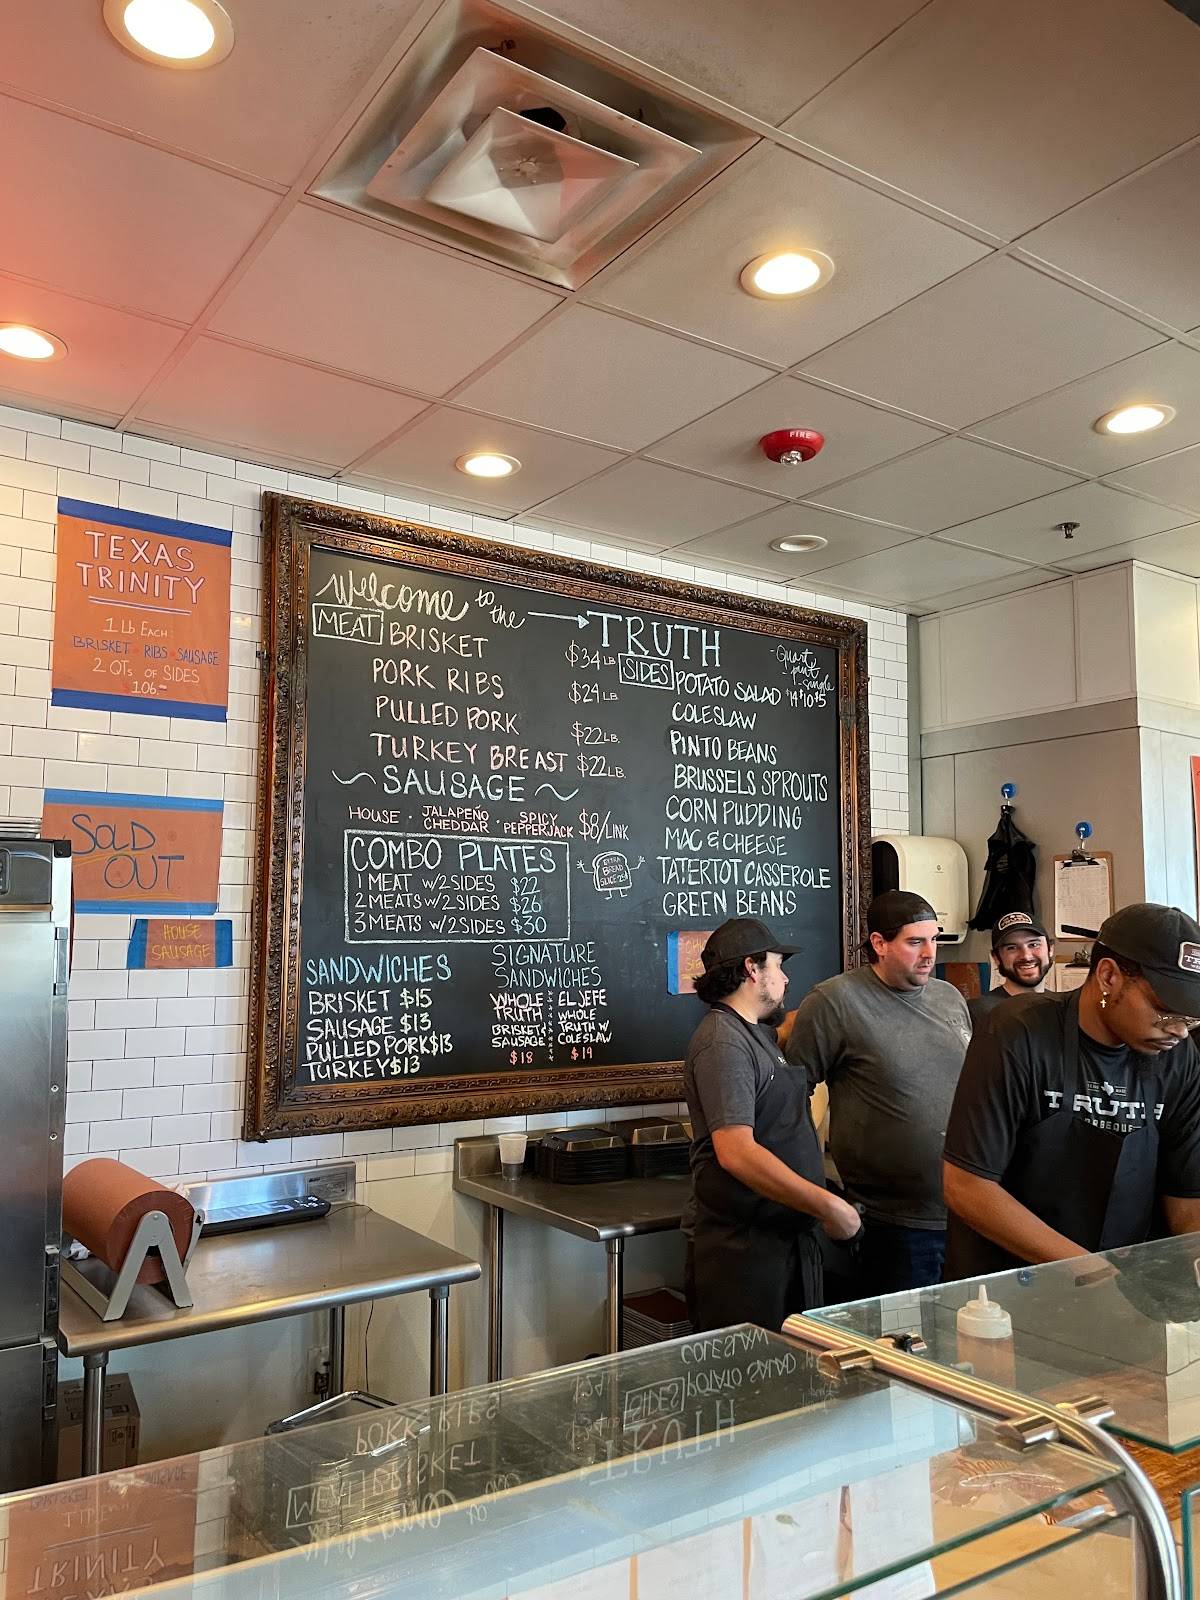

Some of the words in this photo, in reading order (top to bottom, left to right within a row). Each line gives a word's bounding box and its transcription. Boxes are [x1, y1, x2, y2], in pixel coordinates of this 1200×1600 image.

[790, 431, 811, 439] FIRE
[84, 530, 195, 572] TEXAS
[76, 562, 205, 604] TRINITY
[315, 570, 470, 622] Welcome
[475, 588, 496, 608] to
[489, 603, 525, 629] the
[103, 617, 118, 633] 1
[317, 608, 381, 638] MEAT
[73, 635, 132, 654] BRISKET
[144, 644, 168, 659] RIBS
[176, 647, 220, 665] SAUSAGE
[389, 621, 489, 658] BRISKET
[565, 640, 600, 670] $34
[603, 655, 616, 665] LB
[587, 610, 721, 668] TRUTH
[92, 657, 106, 673] 2
[163, 665, 200, 683] SIDES
[373, 657, 436, 690] PORK
[447, 667, 505, 700] RIBS
[602, 691, 618, 701] LB
[622, 658, 669, 685] SIDES
[675, 669, 730, 698] POTATO
[734, 682, 782, 705] SALAD
[799, 688, 814, 708] $10
[814, 690, 826, 708] $5
[375, 695, 459, 728] PULLED
[466, 706, 520, 735] PORK
[571, 720, 606, 747] $22
[672, 702, 757, 730] COLESLAW
[370, 733, 478, 764] TURKEY
[490, 744, 568, 773] BREAST
[577, 752, 607, 778] $22
[669, 729, 722, 761] PINTO
[727, 738, 777, 765] BEANS
[383, 764, 526, 802] SAUSAGE
[674, 763, 757, 796] BRUSSELS
[761, 770, 828, 802] SPROUTS
[348, 805, 400, 824] HOUSE
[422, 804, 490, 822] JALAPEÑO
[423, 816, 490, 833] CHEDDAR
[519, 811, 558, 826] SPICY
[665, 794, 717, 825] CORN
[723, 800, 802, 830] PUDDING
[72, 813, 156, 854] SOLD
[503, 822, 574, 839] PEPPERJACK
[665, 826, 702, 851] MAC
[707, 830, 719, 850] &
[722, 832, 788, 856] CHEESE
[350, 837, 442, 871] COMBO
[458, 843, 556, 873] PLATES
[602, 856, 621, 866] EXTRA
[104, 854, 184, 890] OUT
[600, 873, 617, 886] SLICE
[602, 864, 624, 876] BREAD
[744, 860, 832, 889] CASSEROLE
[357, 873, 363, 889] 1
[369, 873, 412, 892] MEAT
[450, 875, 496, 892] SIDES
[510, 876, 541, 897] $22
[355, 893, 367, 908] 2
[369, 892, 422, 910] MEATS
[456, 895, 500, 911] SIDES
[509, 895, 542, 915] $26
[662, 889, 727, 917] GREEN
[736, 889, 797, 917] BEANS
[163, 923, 202, 941] HOUSE
[354, 913, 367, 933] 3
[369, 913, 422, 933] MEATS
[463, 917, 506, 935] SIDES
[510, 915, 548, 934] $30
[152, 943, 211, 960] SAUSAGE
[491, 941, 596, 967] SIGNATURE
[306, 953, 452, 985] SANDWICHES
[494, 965, 602, 989] SANDWICHES
[308, 989, 391, 1015] BRISKET
[400, 987, 433, 1009] $15
[490, 991, 544, 1009] WHOLE
[558, 990, 577, 1007] EL
[577, 989, 608, 1008] JEFE
[306, 1016, 396, 1042] SAUSAGE
[400, 1012, 432, 1035] $13
[493, 1006, 543, 1023] TRUTH
[558, 1008, 597, 1021] WHOLE
[558, 1020, 596, 1033] TRUTH
[491, 1024, 540, 1036] BRISKET
[491, 1036, 546, 1049] SAUSAGE
[558, 1032, 612, 1045] COLESLAW
[305, 1039, 381, 1062] PULLED
[384, 1035, 430, 1056] PORK
[429, 1031, 454, 1056] $13
[509, 1049, 533, 1065] $18
[301, 1057, 390, 1082] TURKEY
[390, 1055, 421, 1076] $13
